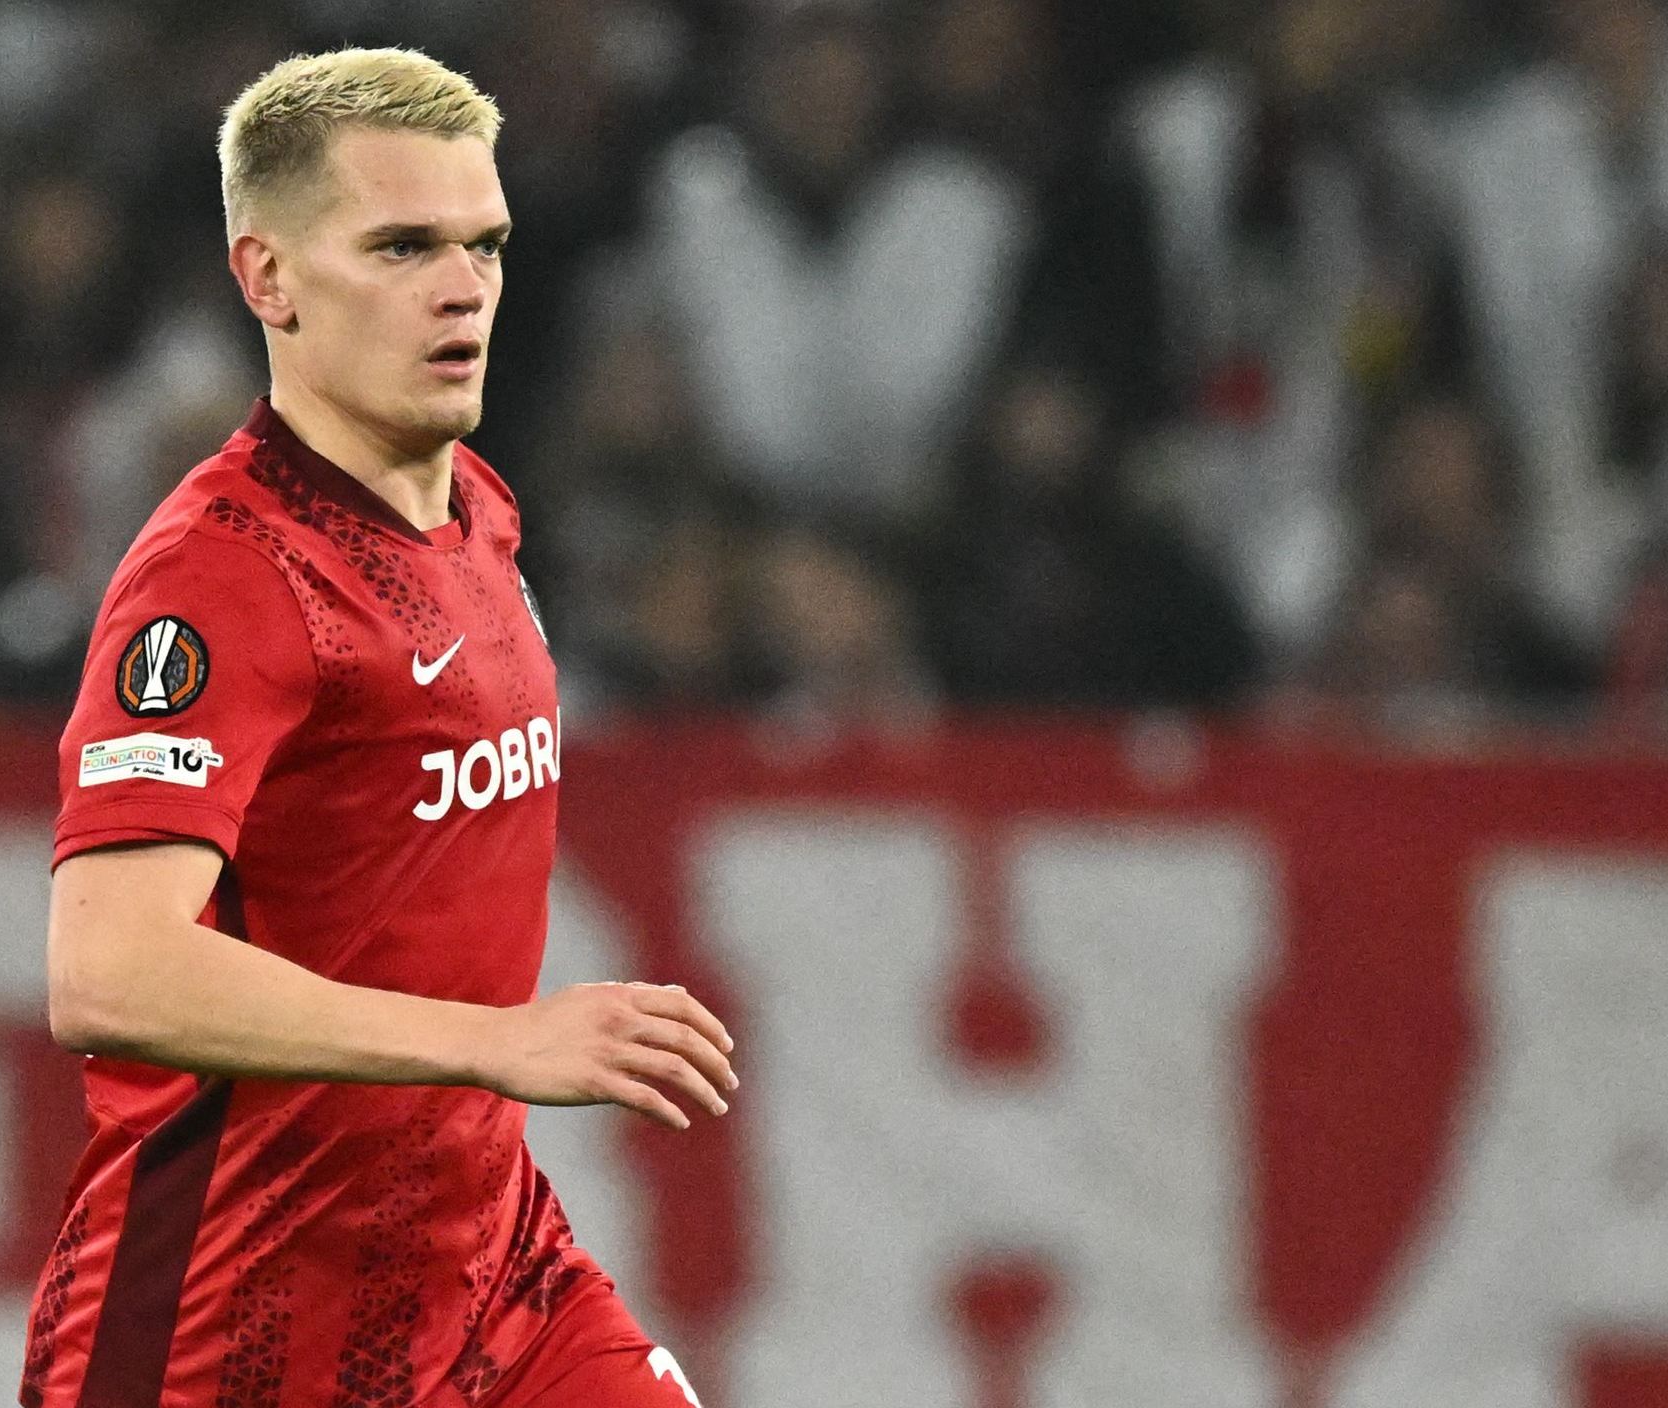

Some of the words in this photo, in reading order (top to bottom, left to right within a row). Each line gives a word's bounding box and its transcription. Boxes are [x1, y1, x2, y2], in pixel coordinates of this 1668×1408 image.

[83, 749, 166, 769] FOUNDATION
[169, 747, 203, 772] 10
[412, 704, 561, 822] JOBR
